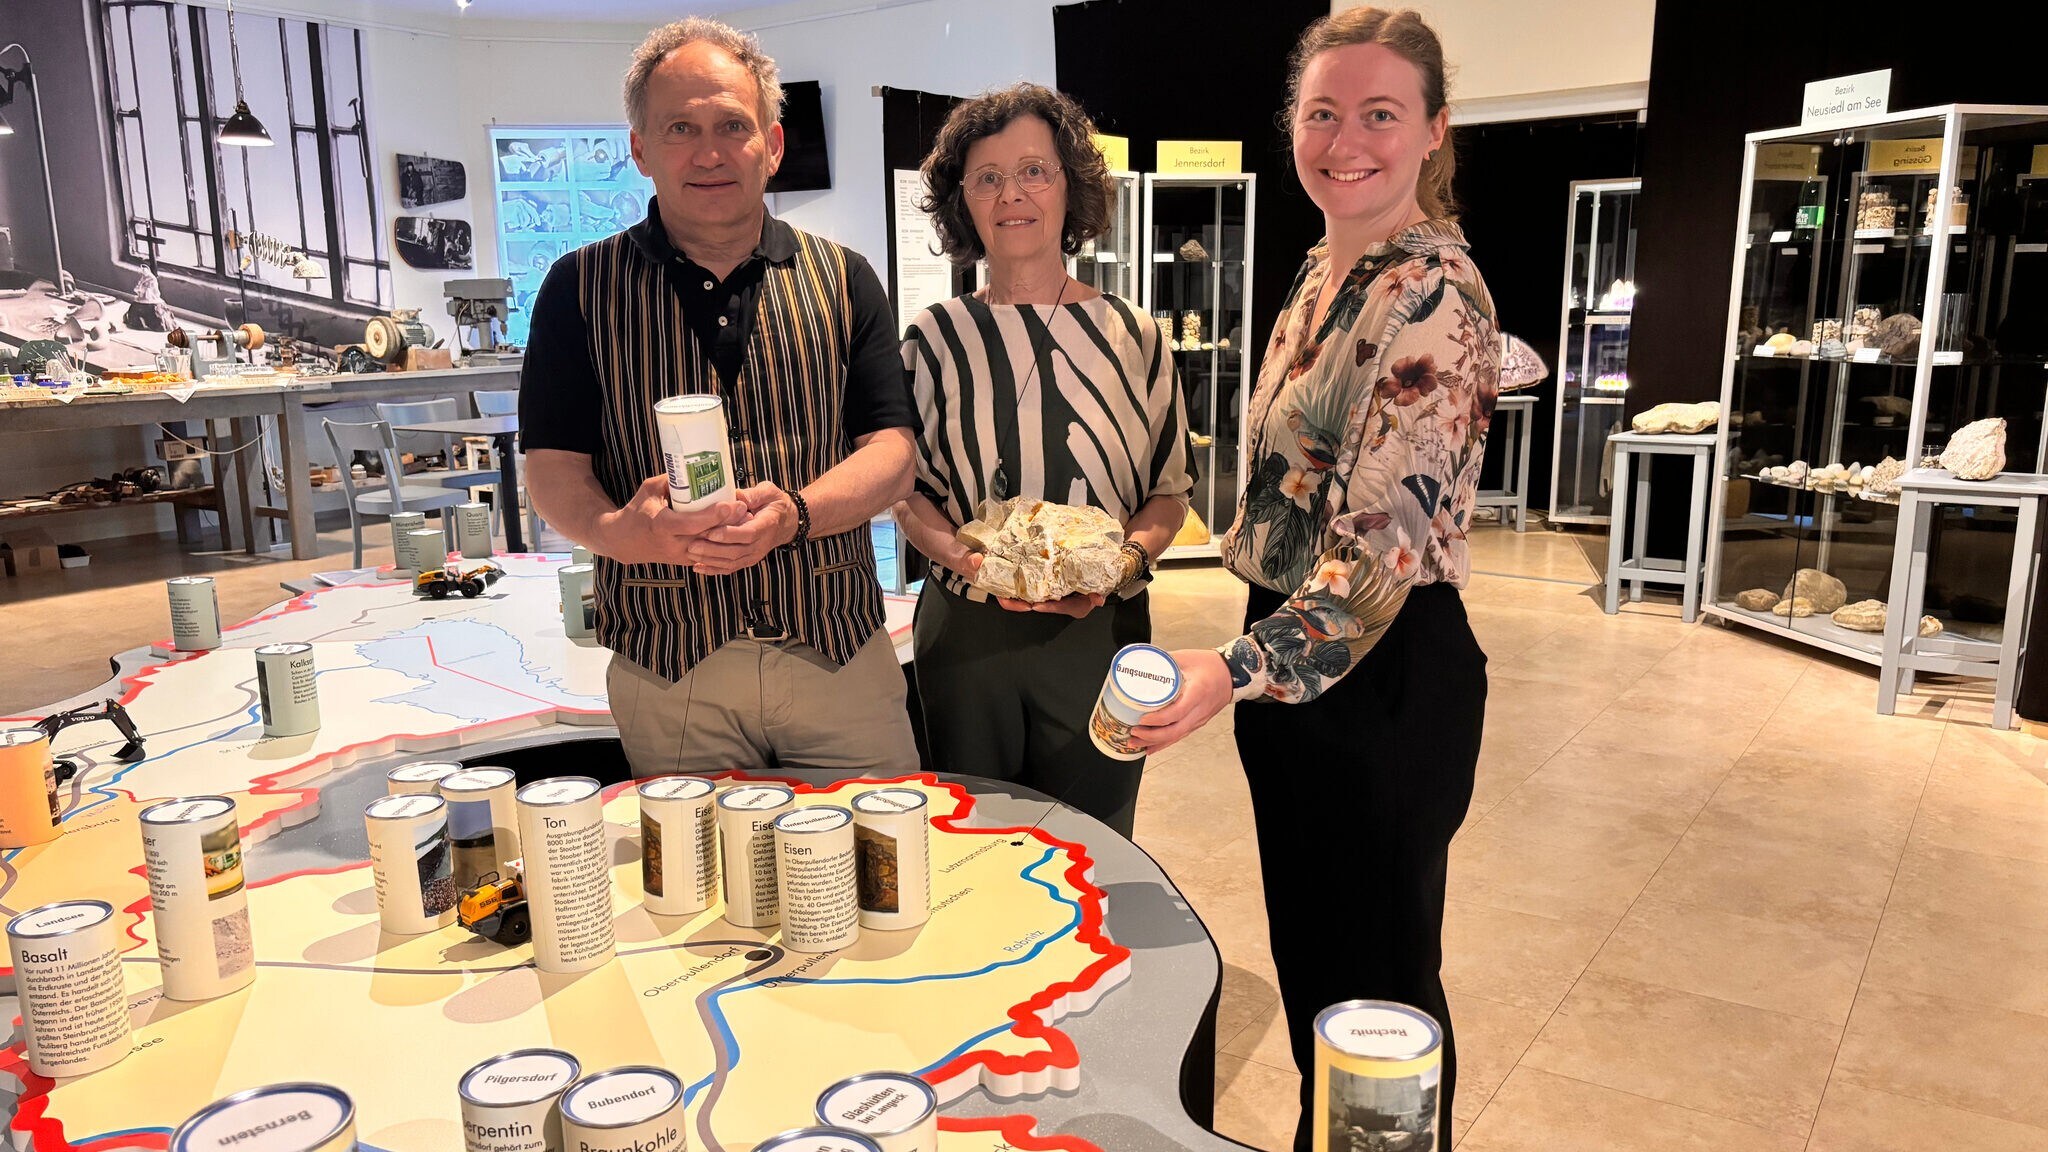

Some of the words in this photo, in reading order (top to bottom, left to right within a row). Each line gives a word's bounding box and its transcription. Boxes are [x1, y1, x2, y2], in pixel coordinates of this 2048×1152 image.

[1835, 84, 1855, 95] Bezirk
[1807, 101, 1844, 117] Neusiedl
[1847, 101, 1861, 111] am
[1865, 96, 1881, 109] See
[1174, 158, 1225, 168] Jennersdorf
[1117, 664, 1175, 686] Lutzmannsburg
[543, 817, 566, 828] Ton
[752, 821, 774, 832] Eise
[783, 812, 842, 829] Unterpullendorf
[784, 843, 812, 855] Eisen
[938, 838, 1007, 873] Lutzmannsburg
[930, 887, 973, 915] mutschen
[36, 912, 85, 928] Landsee
[1003, 930, 1045, 953] Rabnitz
[22, 948, 68, 963] Basalt
[643, 946, 740, 997] Oberpullendorf
[762, 948, 840, 988] Unterpullen
[1350, 1028, 1408, 1037] Rechnitz
[485, 1073, 557, 1084] Pilgersdorf
[587, 1086, 656, 1109] Bubendorf
[842, 1086, 896, 1121] Glashütten
[858, 1112, 876, 1124] bei
[875, 1092, 908, 1117] Langeck
[218, 1110, 313, 1146] Bernstein
[524, 1141, 542, 1149] zum
[580, 1127, 677, 1152] Bkohle
